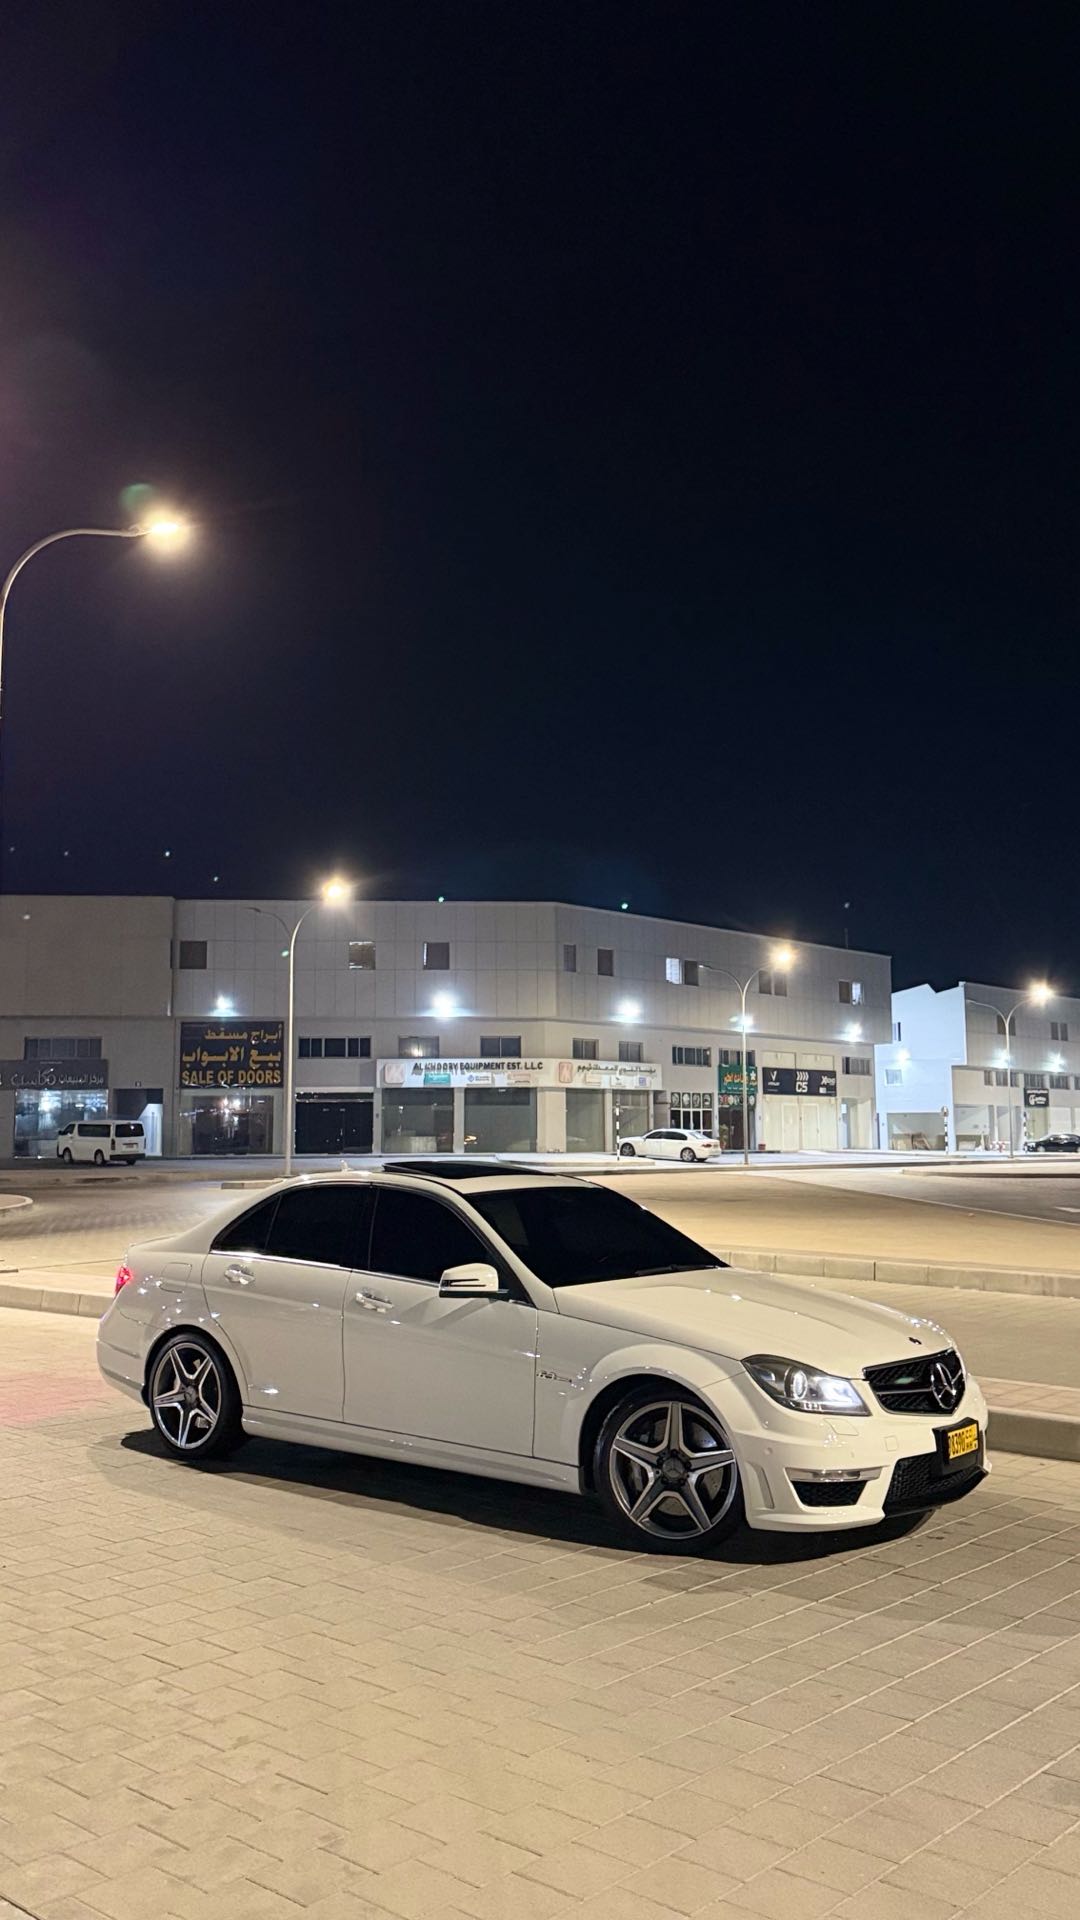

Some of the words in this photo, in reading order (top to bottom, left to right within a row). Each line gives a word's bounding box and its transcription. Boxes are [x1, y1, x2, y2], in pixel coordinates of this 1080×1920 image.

[204, 1027, 248, 1040] مسقط
[249, 1049, 282, 1070] بيع
[412, 1062, 424, 1071] AL
[460, 1062, 505, 1071] EQUIPMENT
[506, 1062, 523, 1071] EST.
[182, 1070, 214, 1085] SALE
[217, 1070, 235, 1085] OF
[238, 1070, 282, 1085] DOORS
